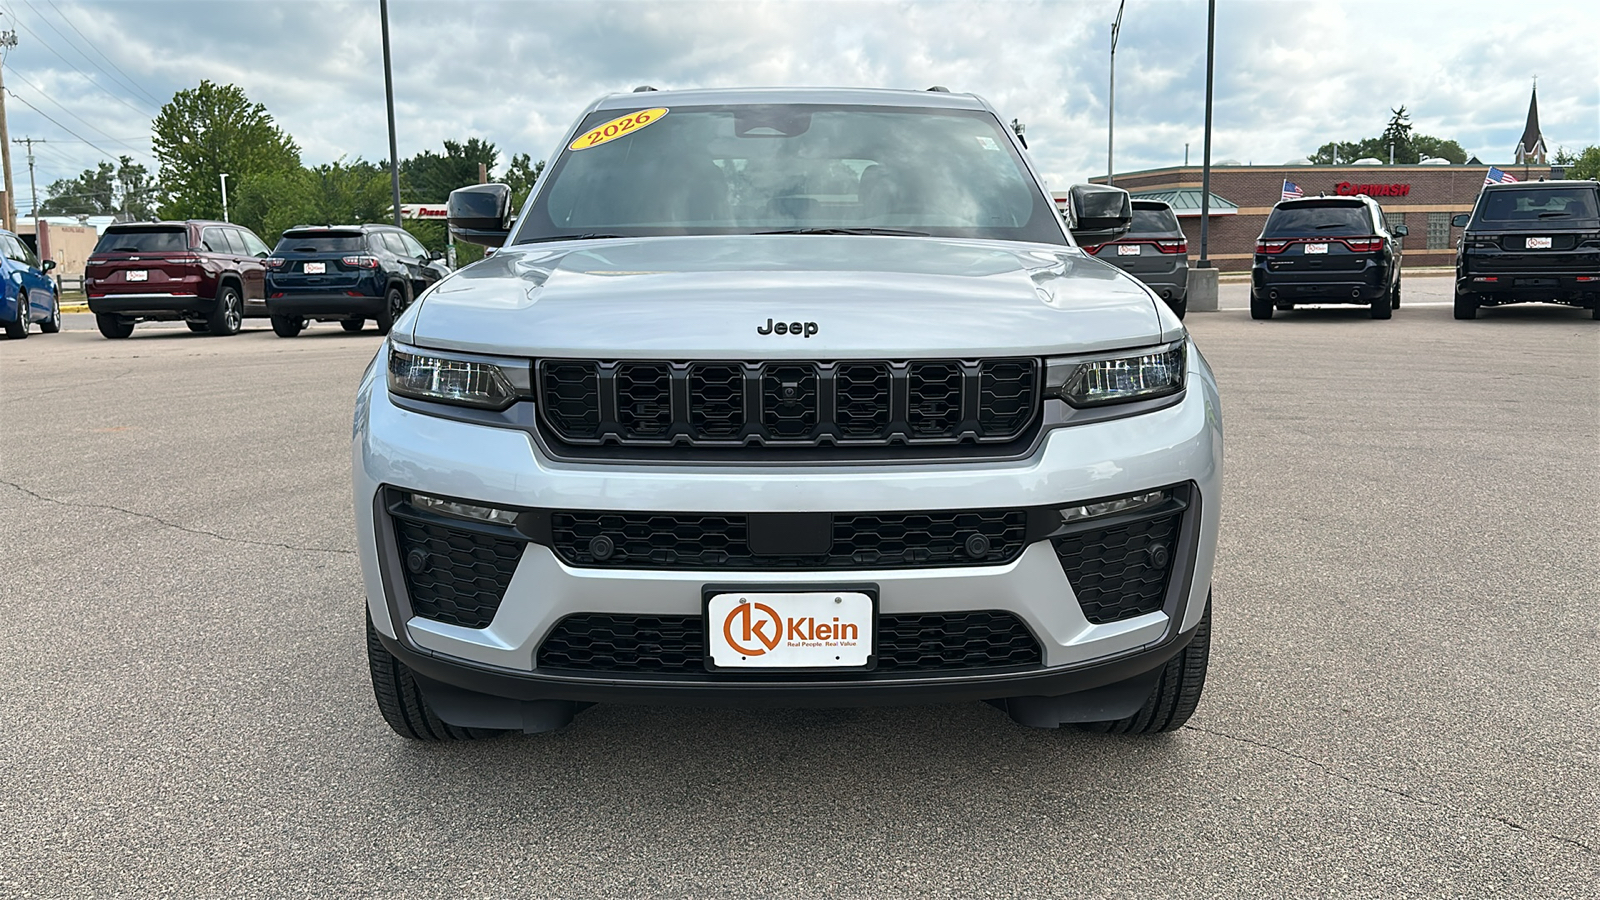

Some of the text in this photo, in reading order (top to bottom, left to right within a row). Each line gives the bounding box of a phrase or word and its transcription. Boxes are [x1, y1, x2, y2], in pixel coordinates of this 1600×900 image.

[587, 111, 650, 145] 2026
[1336, 181, 1411, 196] CARWASH
[757, 318, 818, 338] Jeep
[787, 617, 858, 640] Klein
